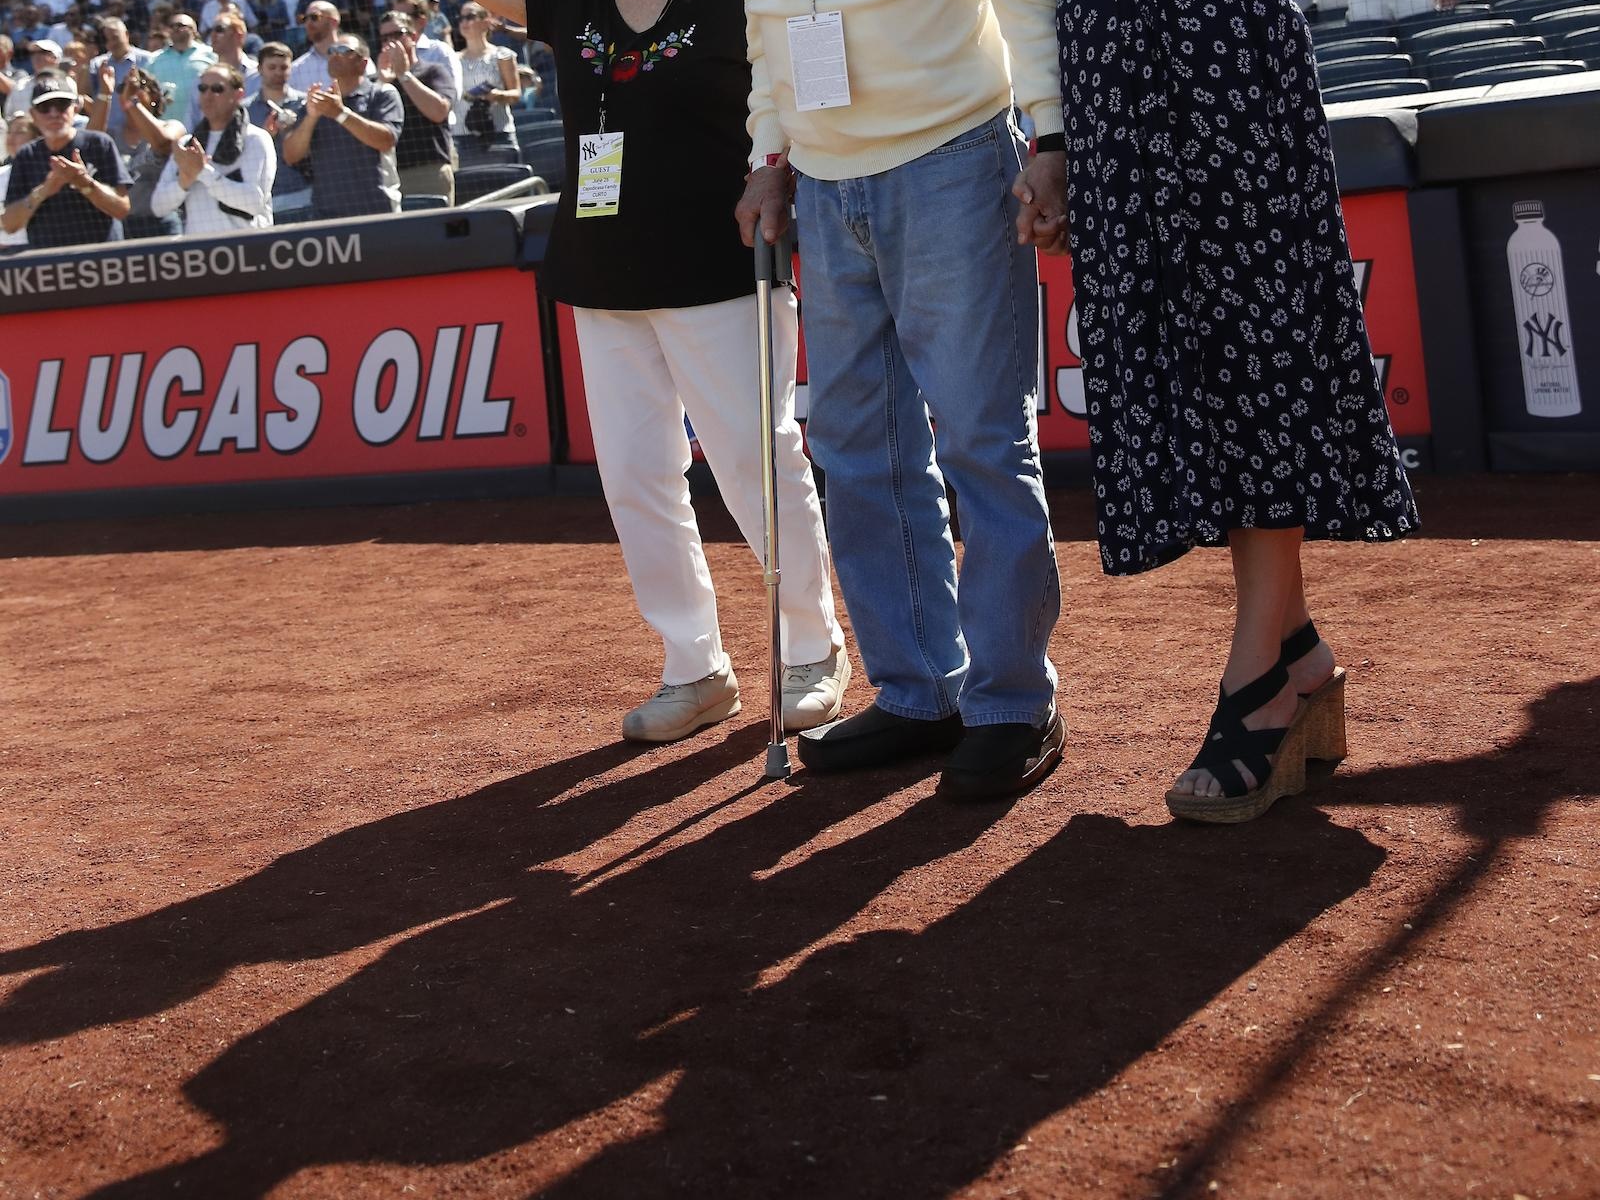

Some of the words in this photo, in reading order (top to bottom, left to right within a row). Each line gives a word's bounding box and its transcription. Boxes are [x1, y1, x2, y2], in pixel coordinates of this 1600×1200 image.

[582, 141, 597, 160] NY
[590, 166, 610, 174] GUEST
[1523, 312, 1567, 358] NY
[21, 335, 330, 468] LUCAS
[352, 321, 516, 448] OIL
